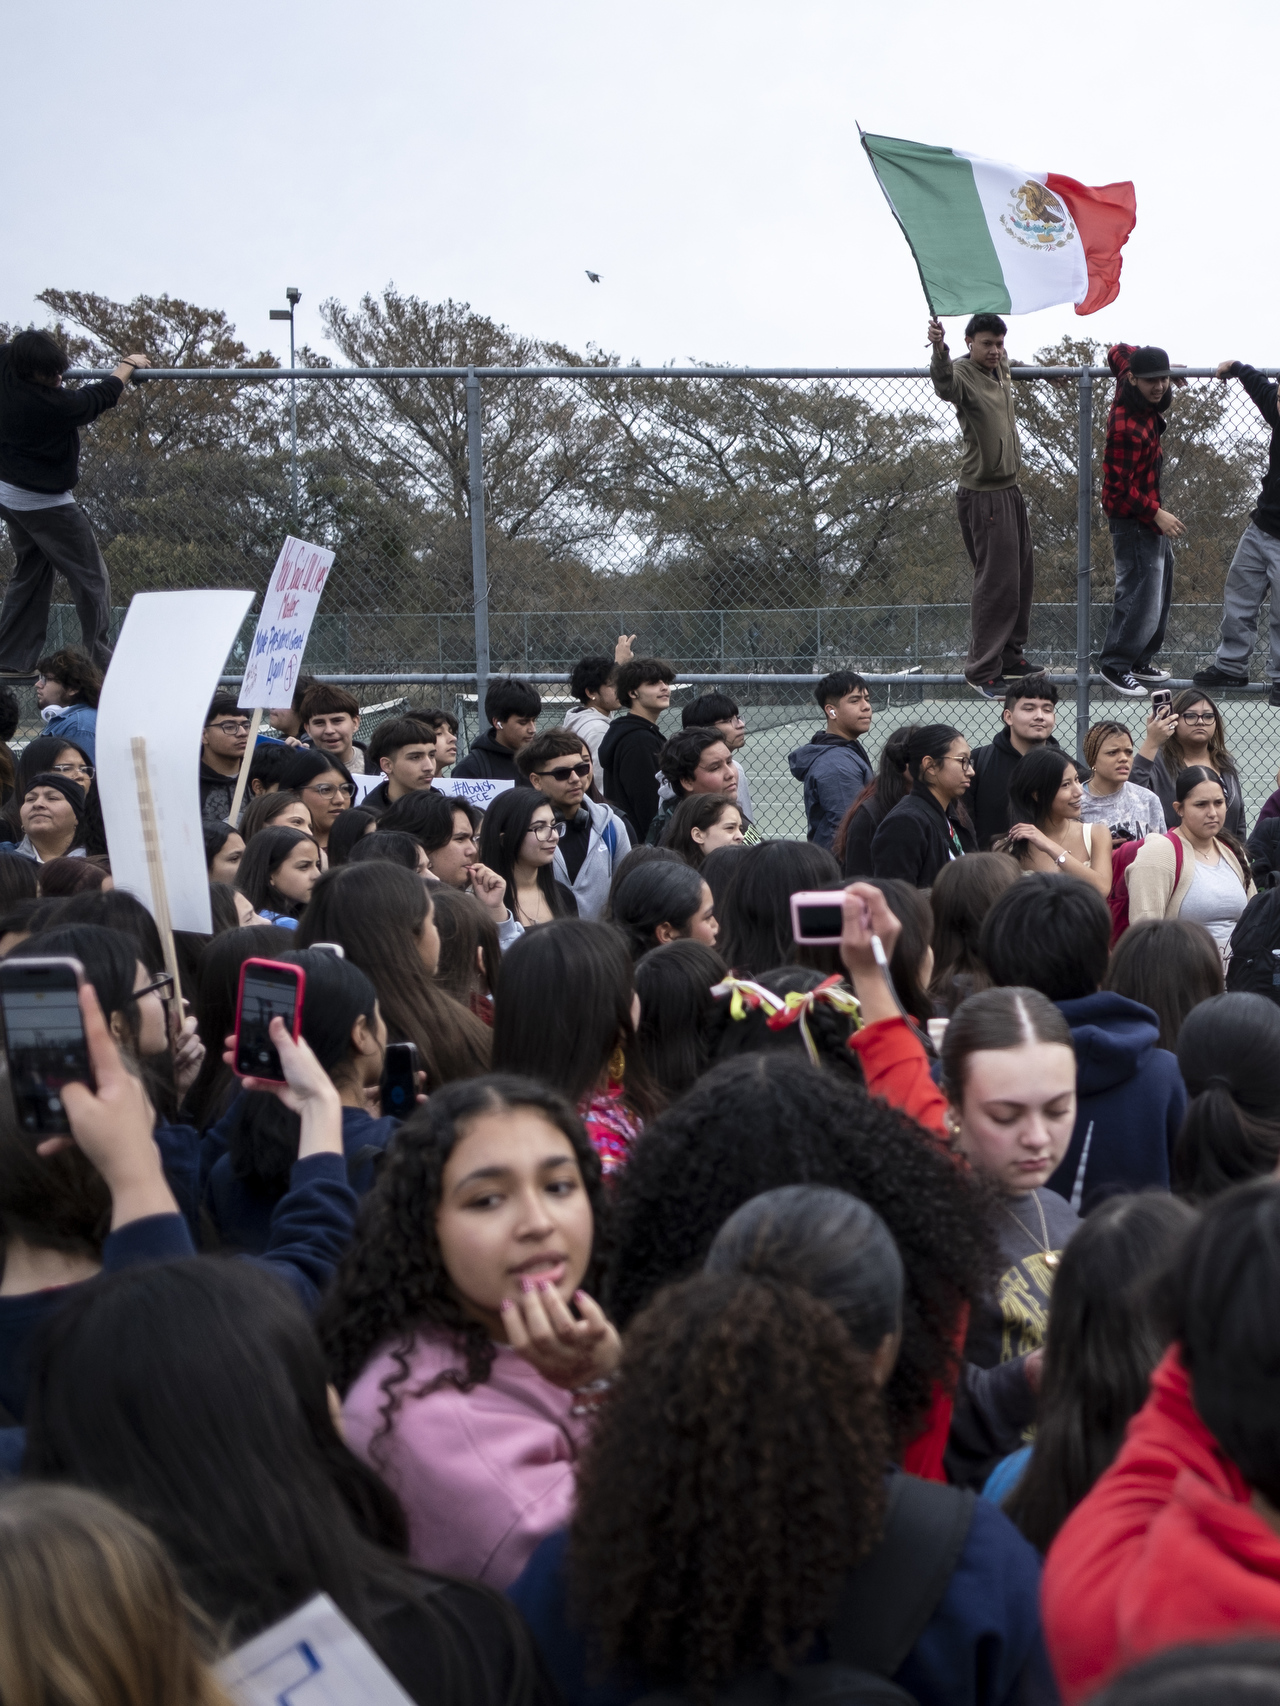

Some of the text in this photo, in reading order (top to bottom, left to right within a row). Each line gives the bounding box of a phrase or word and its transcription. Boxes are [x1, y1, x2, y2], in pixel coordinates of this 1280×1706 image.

[276, 537, 296, 593] You
[287, 546, 310, 591] Said
[452, 780, 496, 797] #Abolish
